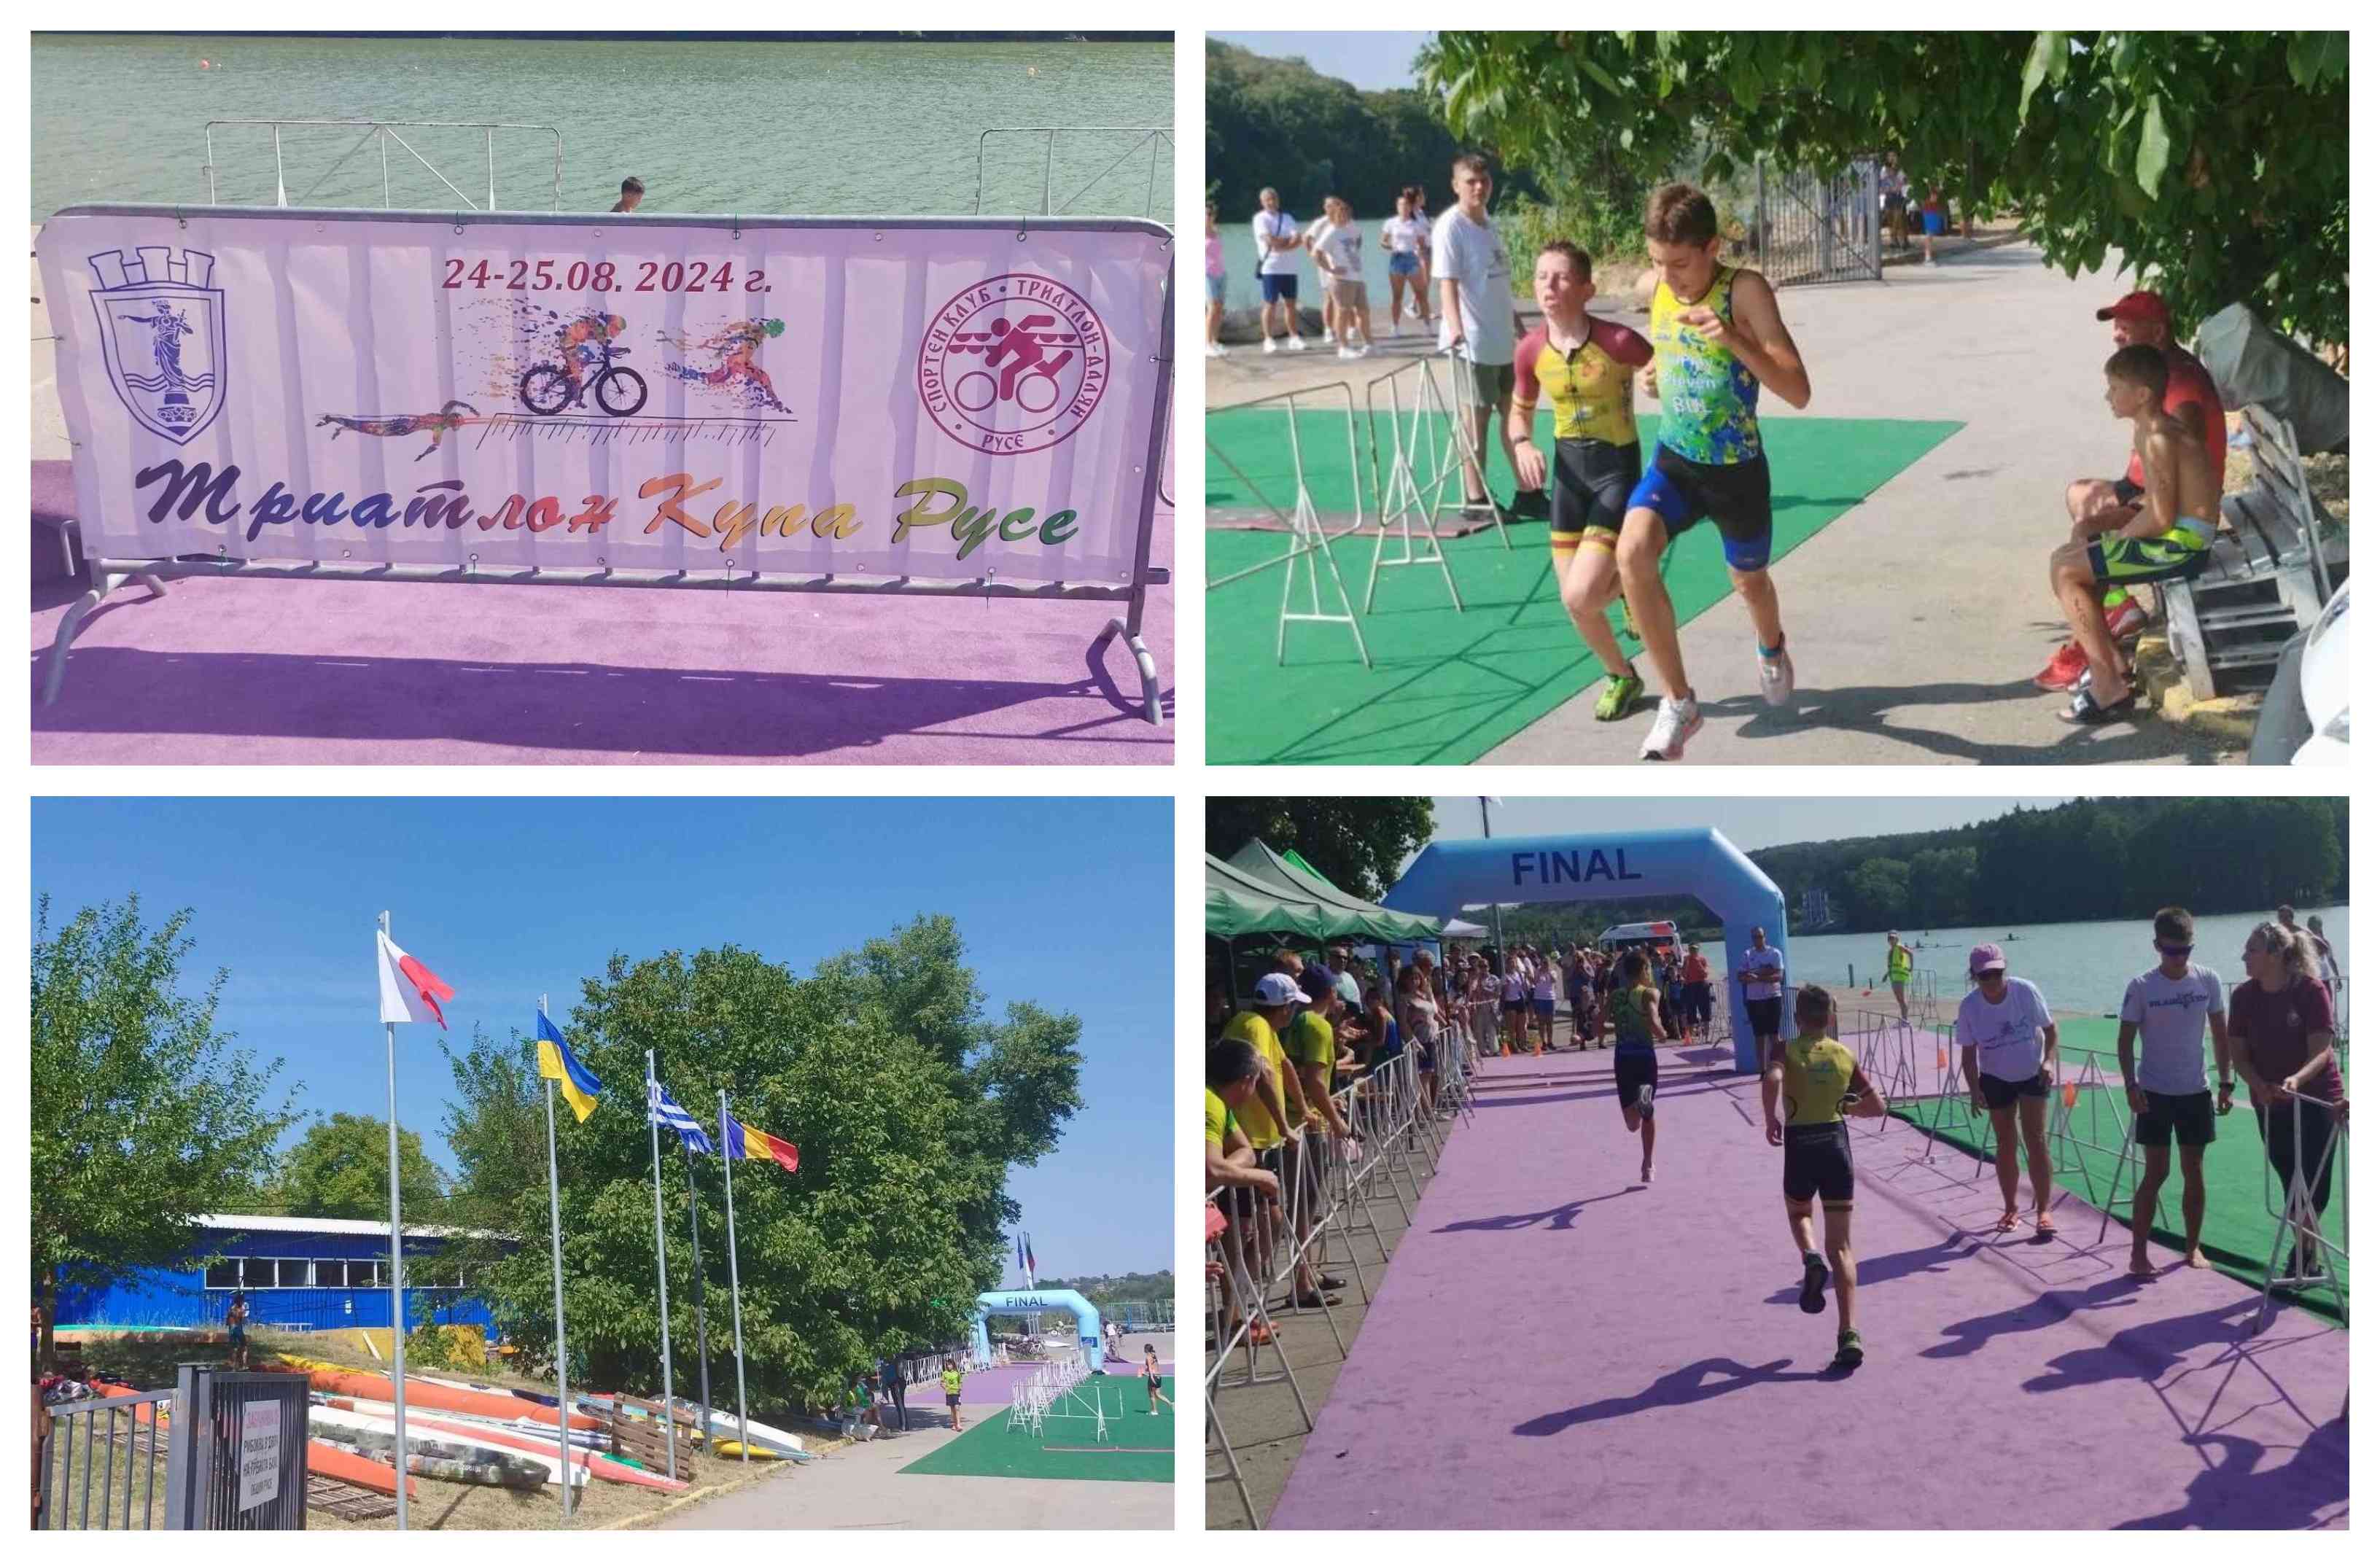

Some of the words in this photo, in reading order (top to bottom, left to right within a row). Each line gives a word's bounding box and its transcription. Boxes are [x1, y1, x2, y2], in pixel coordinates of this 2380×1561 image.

[442, 259, 623, 292] 24-25.08.
[634, 261, 735, 292] 2024
[744, 269, 773, 292] г.
[923, 328, 949, 413] СПОРТЕН
[943, 287, 992, 327] КЛУБ
[1017, 279, 1105, 419] ТРИАТЛОН-ДАЛЯН
[981, 434, 1024, 451] РУСЕ
[136, 459, 619, 542] Триатлон
[637, 472, 864, 553] Купа
[891, 477, 1080, 561] Русе
[1512, 847, 1642, 886] FINAL
[1006, 1295, 1049, 1307] FINAL
